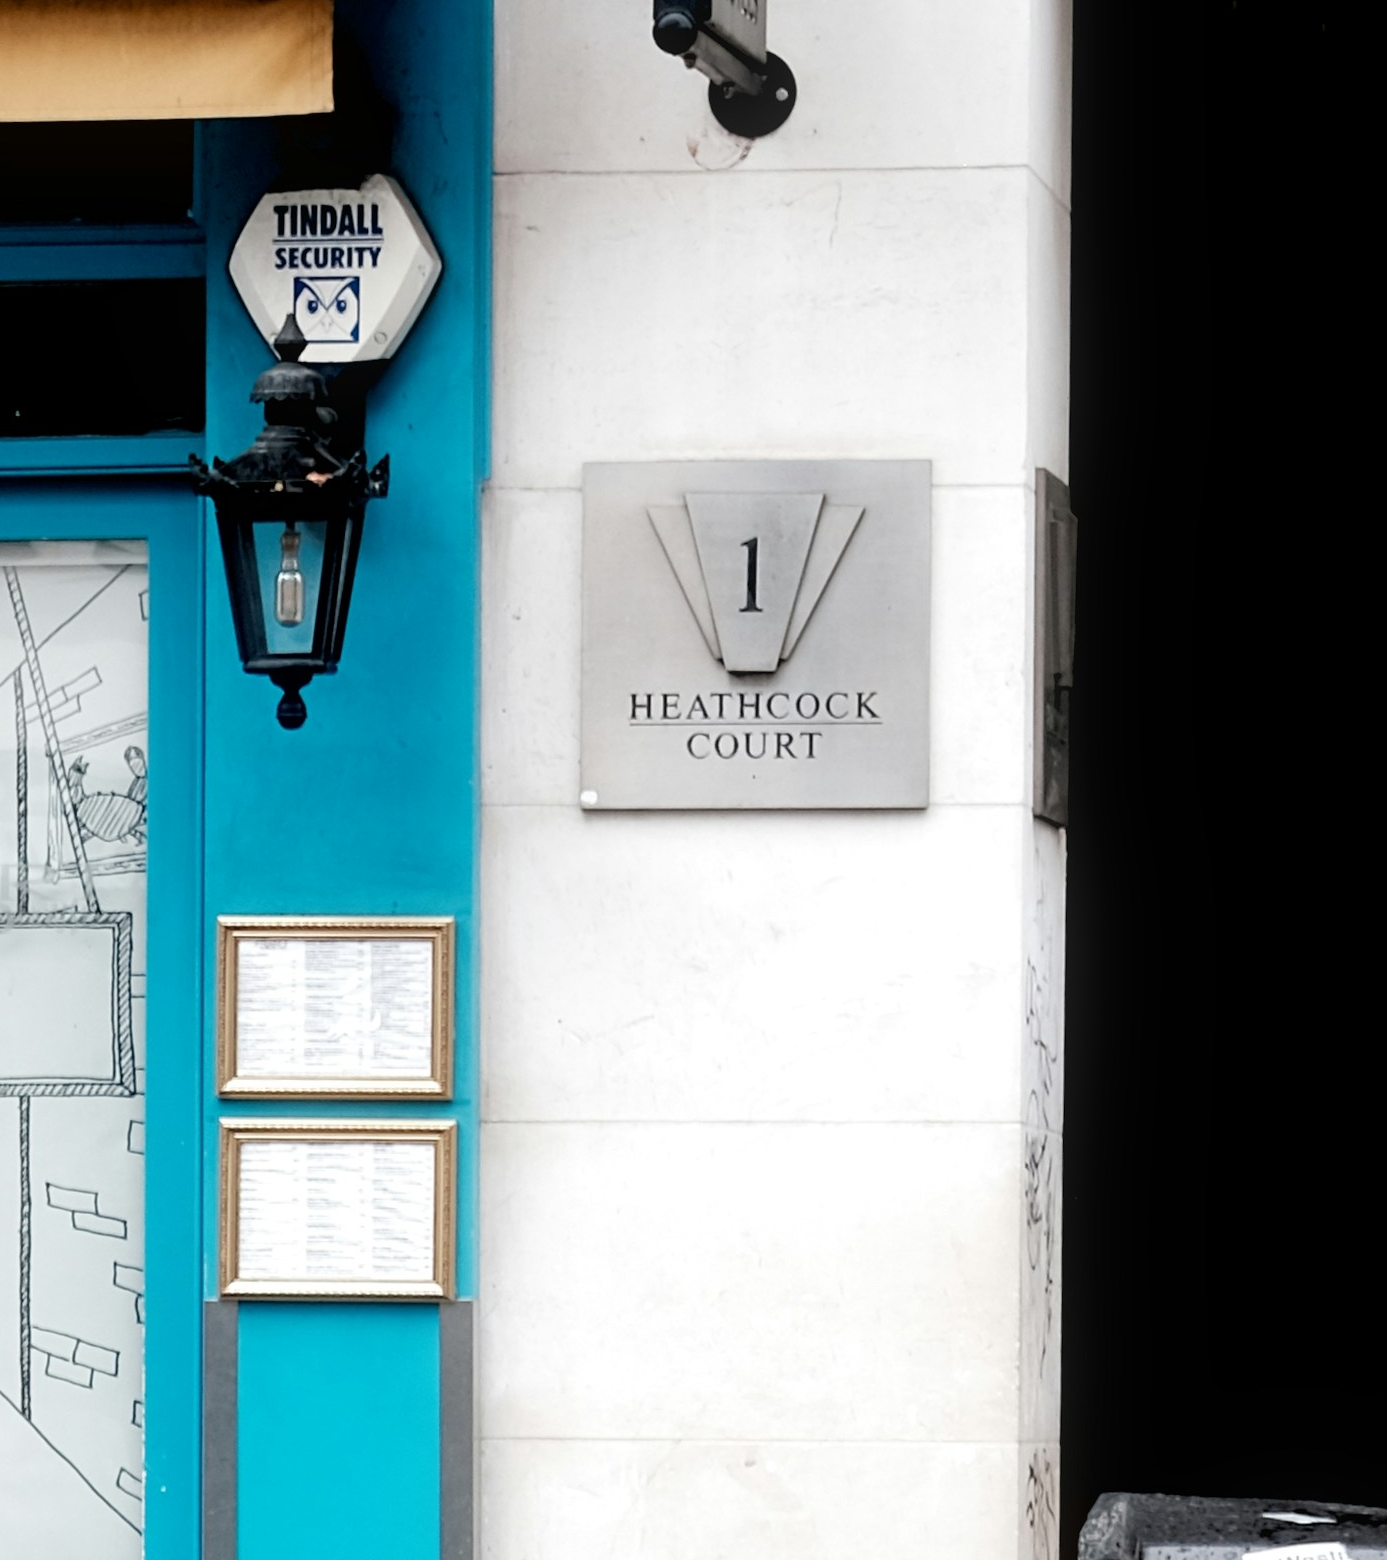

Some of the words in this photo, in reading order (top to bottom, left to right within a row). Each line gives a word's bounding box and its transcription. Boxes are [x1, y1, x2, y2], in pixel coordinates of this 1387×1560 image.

[274, 204, 383, 237] TINDALL
[275, 246, 382, 270] SECURITY
[739, 536, 764, 613] 1
[629, 692, 881, 721] HEATHCOCK
[686, 732, 823, 760] COURT
